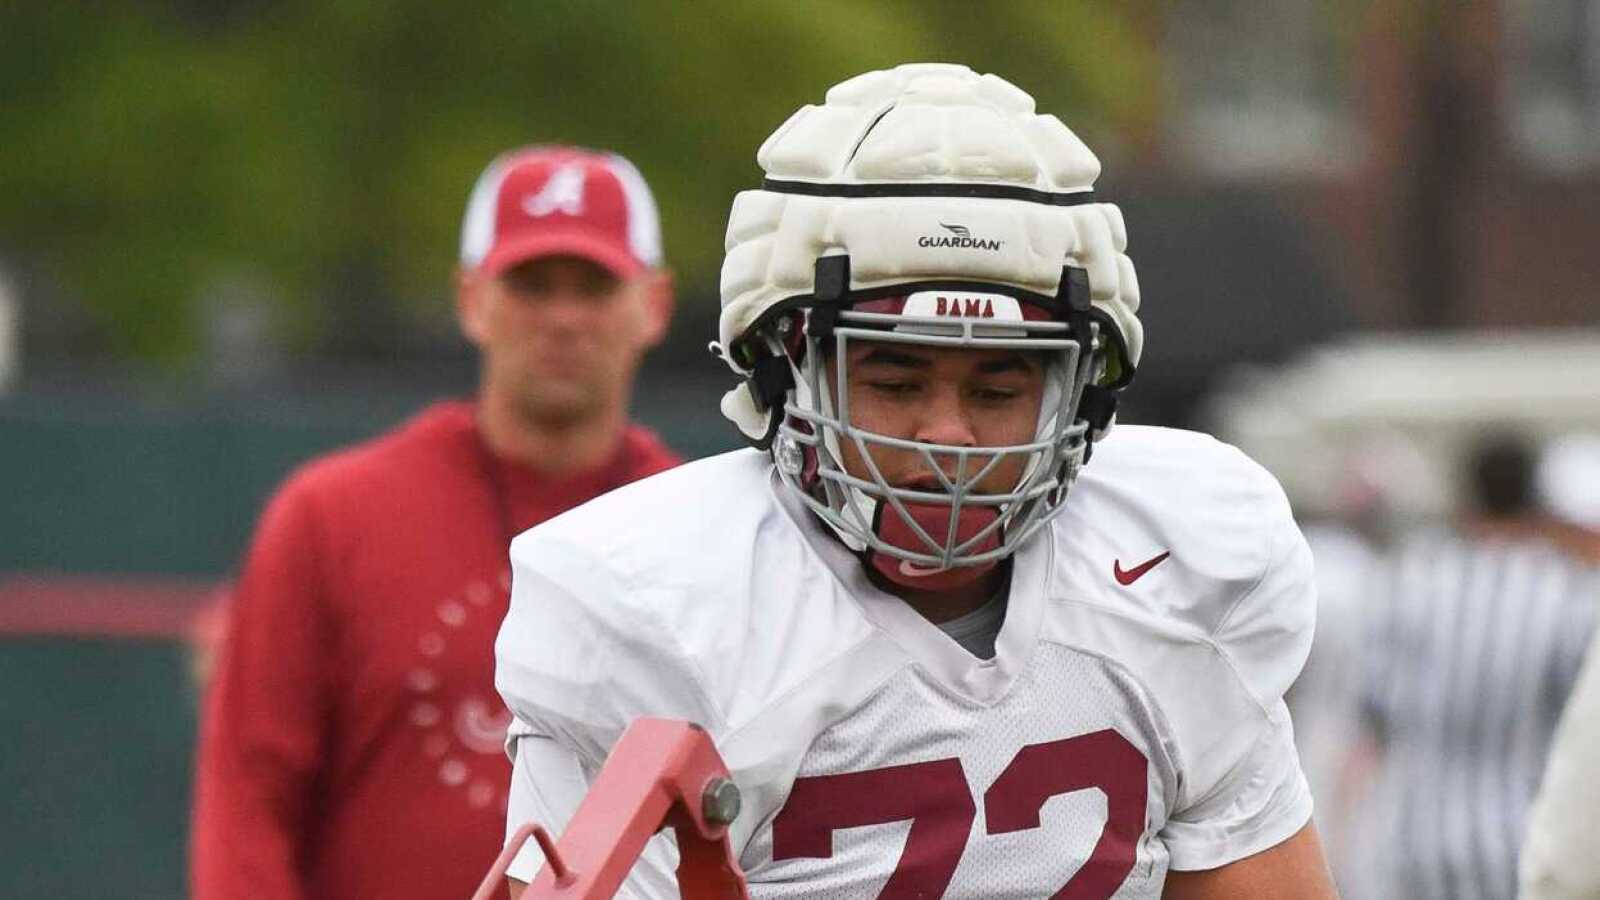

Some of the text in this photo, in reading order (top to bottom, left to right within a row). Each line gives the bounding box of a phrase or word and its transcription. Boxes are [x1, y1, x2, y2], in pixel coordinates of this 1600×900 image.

[918, 236, 1001, 251] GUARDIAN
[936, 297, 994, 318] BAMA
[772, 728, 1149, 900] 72
